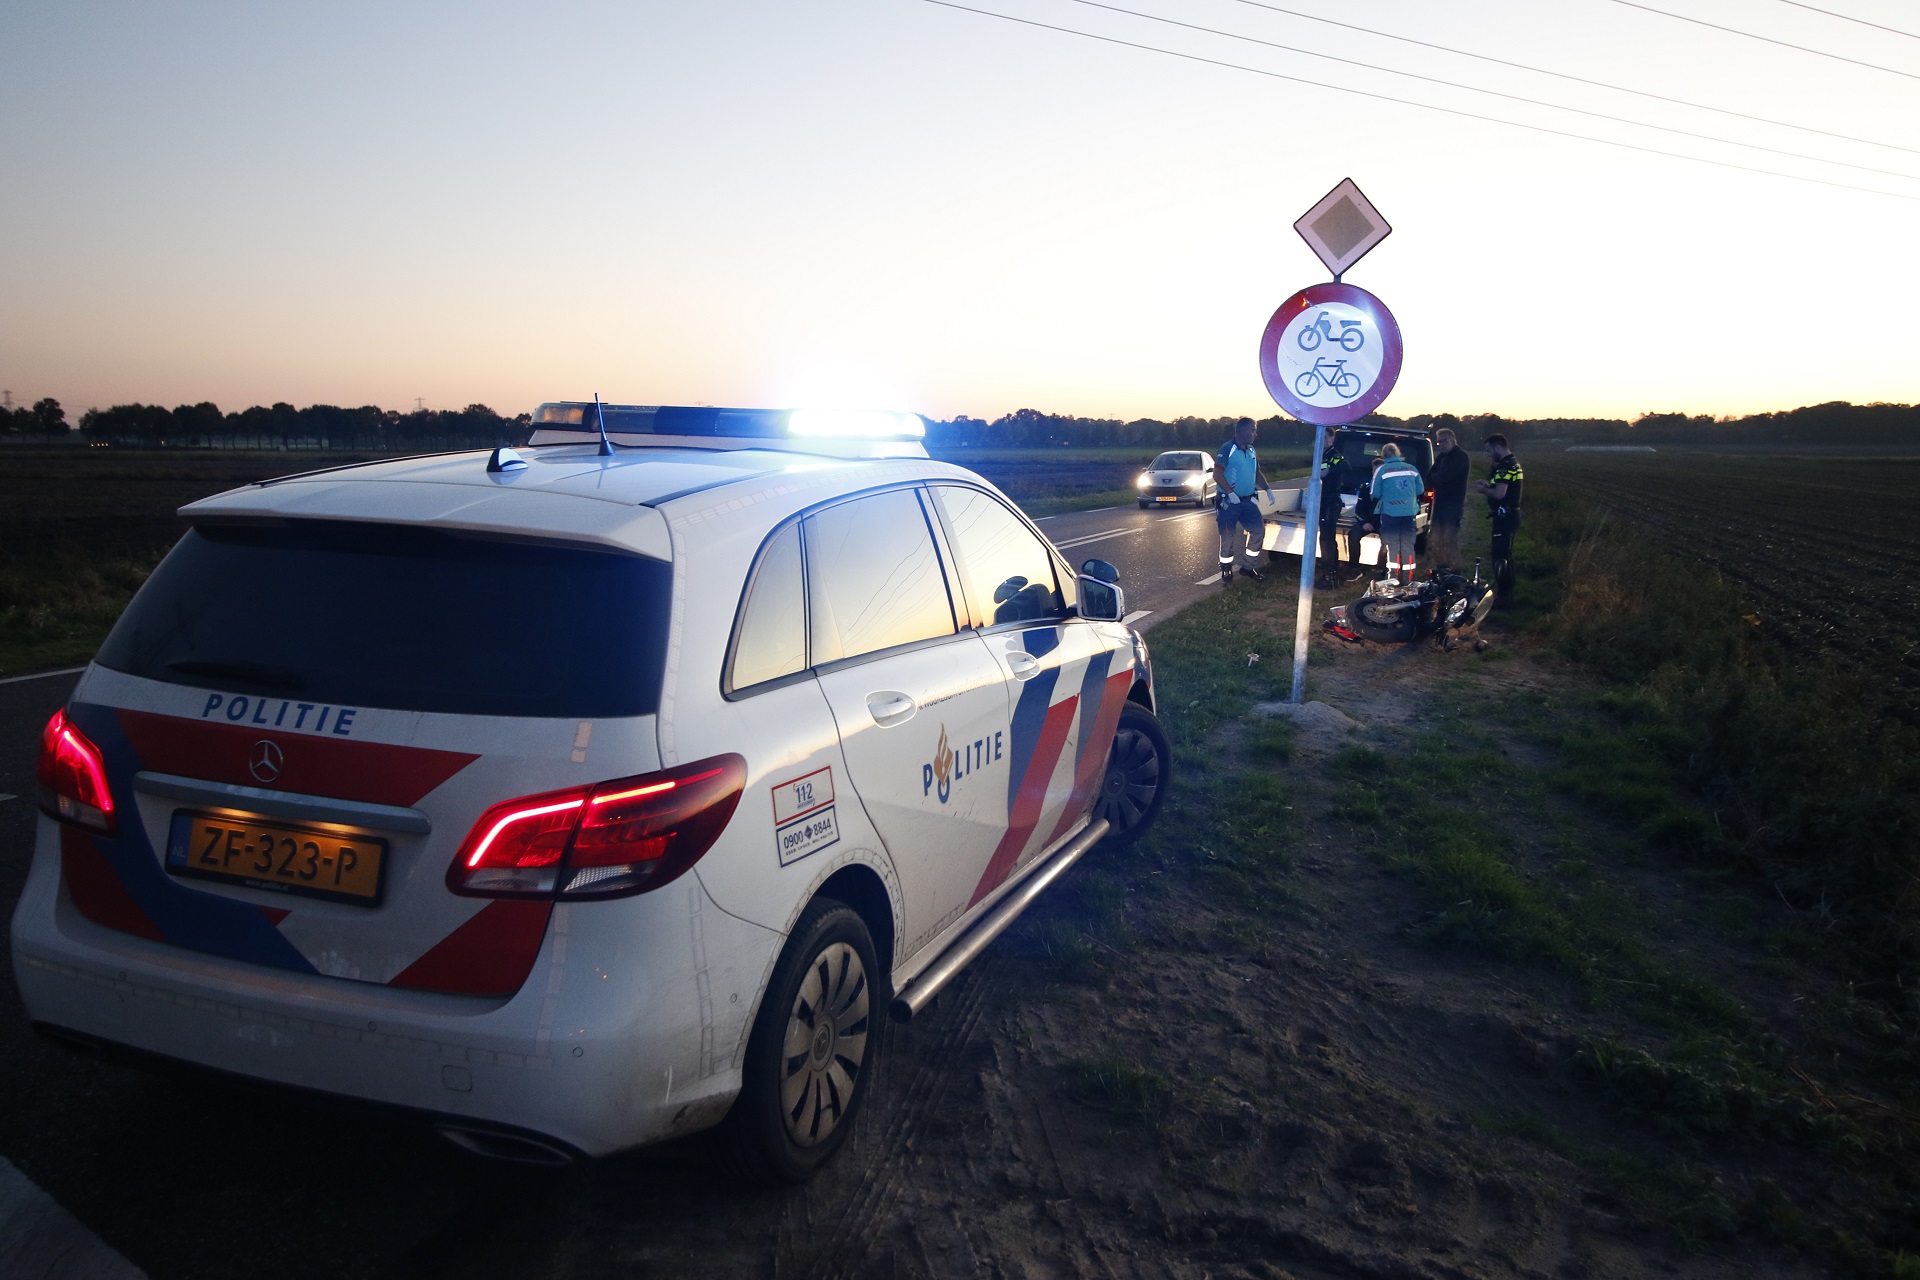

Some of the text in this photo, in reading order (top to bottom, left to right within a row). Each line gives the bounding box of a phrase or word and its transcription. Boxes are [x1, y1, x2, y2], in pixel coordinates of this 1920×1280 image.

[202, 693, 358, 736] POLITIE
[922, 730, 1002, 804] POLITIE
[172, 846, 186, 859] NL
[783, 817, 831, 849] 0900 8844
[199, 825, 358, 886] ZF-323-P
